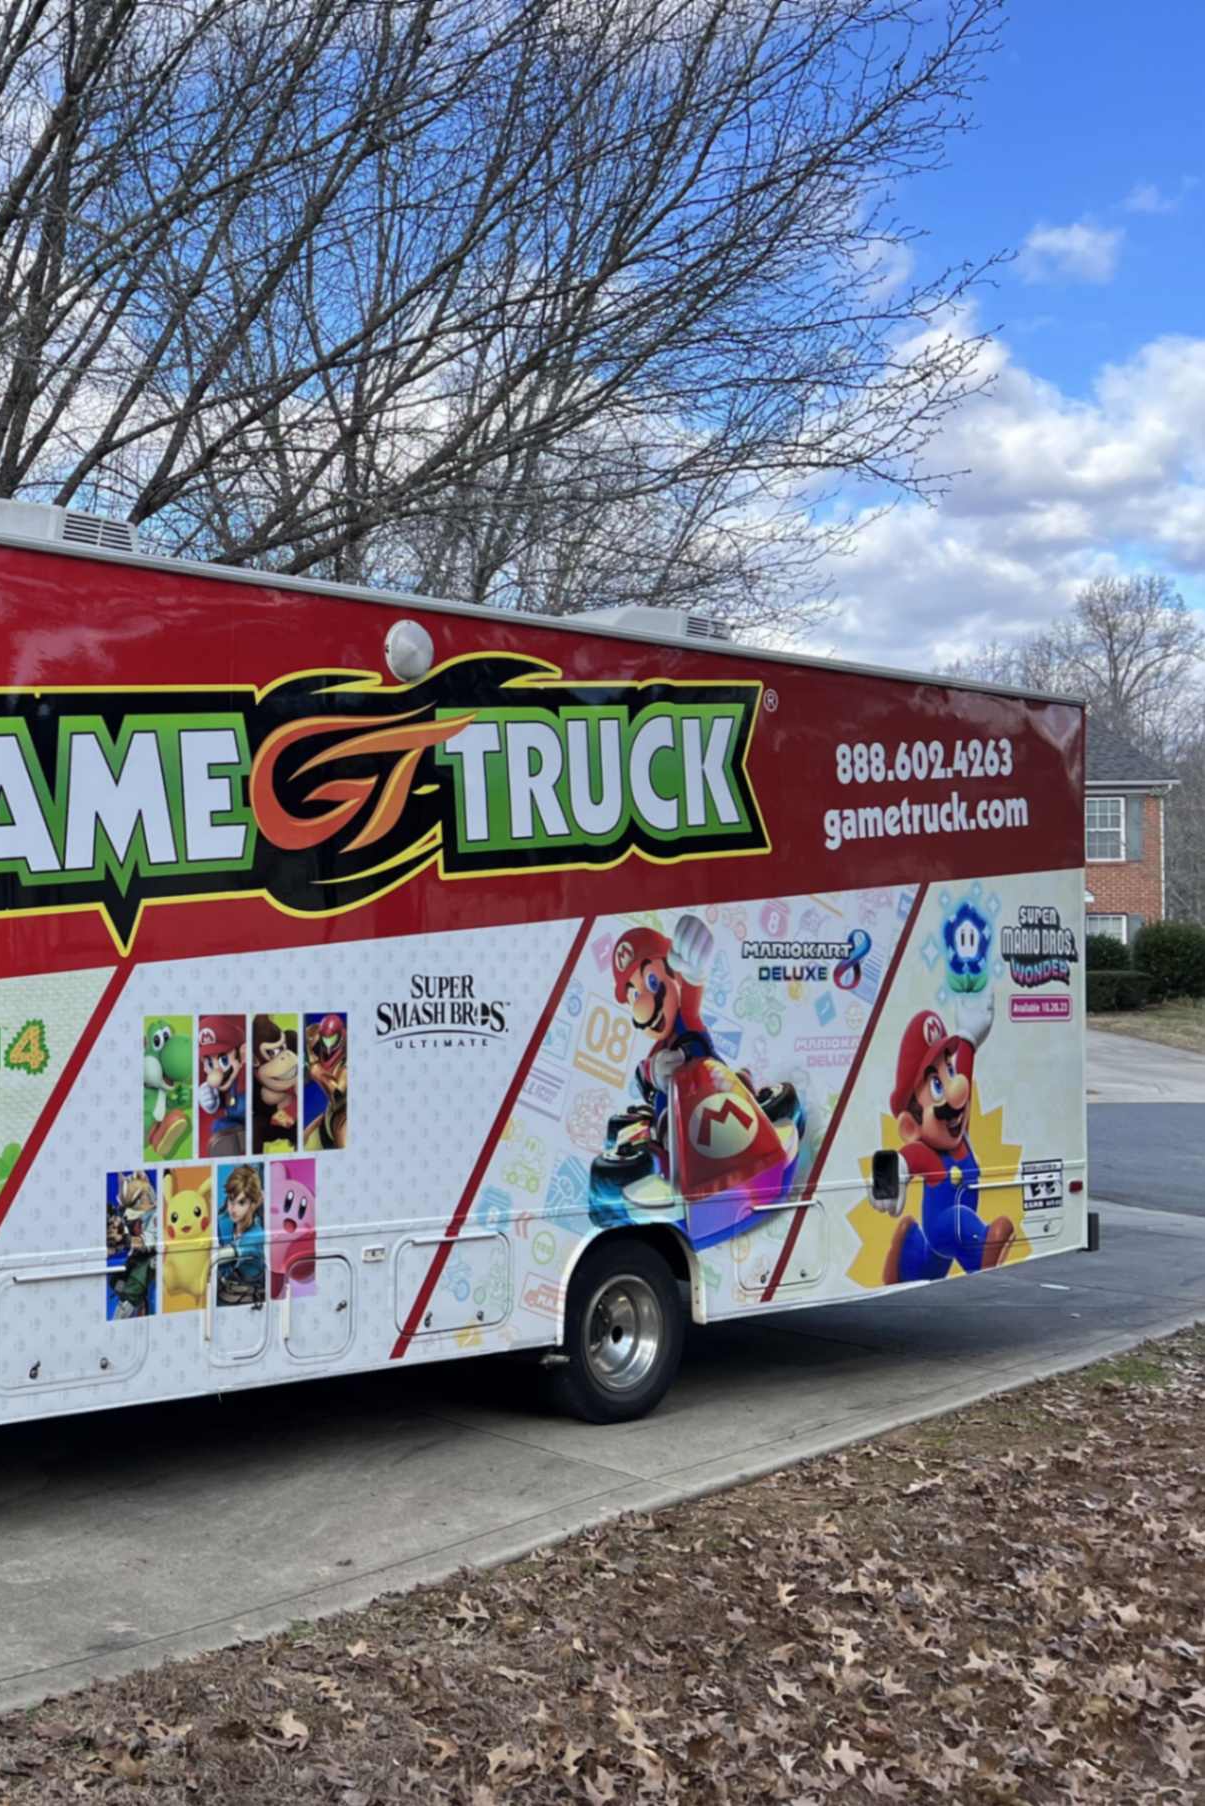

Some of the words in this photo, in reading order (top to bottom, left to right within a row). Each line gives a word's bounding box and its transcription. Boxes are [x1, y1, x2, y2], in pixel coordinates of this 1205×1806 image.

[444, 715, 742, 842] TRUCK
[836, 738, 1013, 784] 888.602.4263
[824, 791, 1029, 850] gametruck.com
[1019, 906, 1059, 926] SUPER
[410, 973, 475, 999] SUPER
[758, 966, 828, 981] DELUXE
[375, 1001, 444, 1036] SMASH
[4, 1019, 50, 1075] 4
[395, 1038, 488, 1049] ULTIMATE
